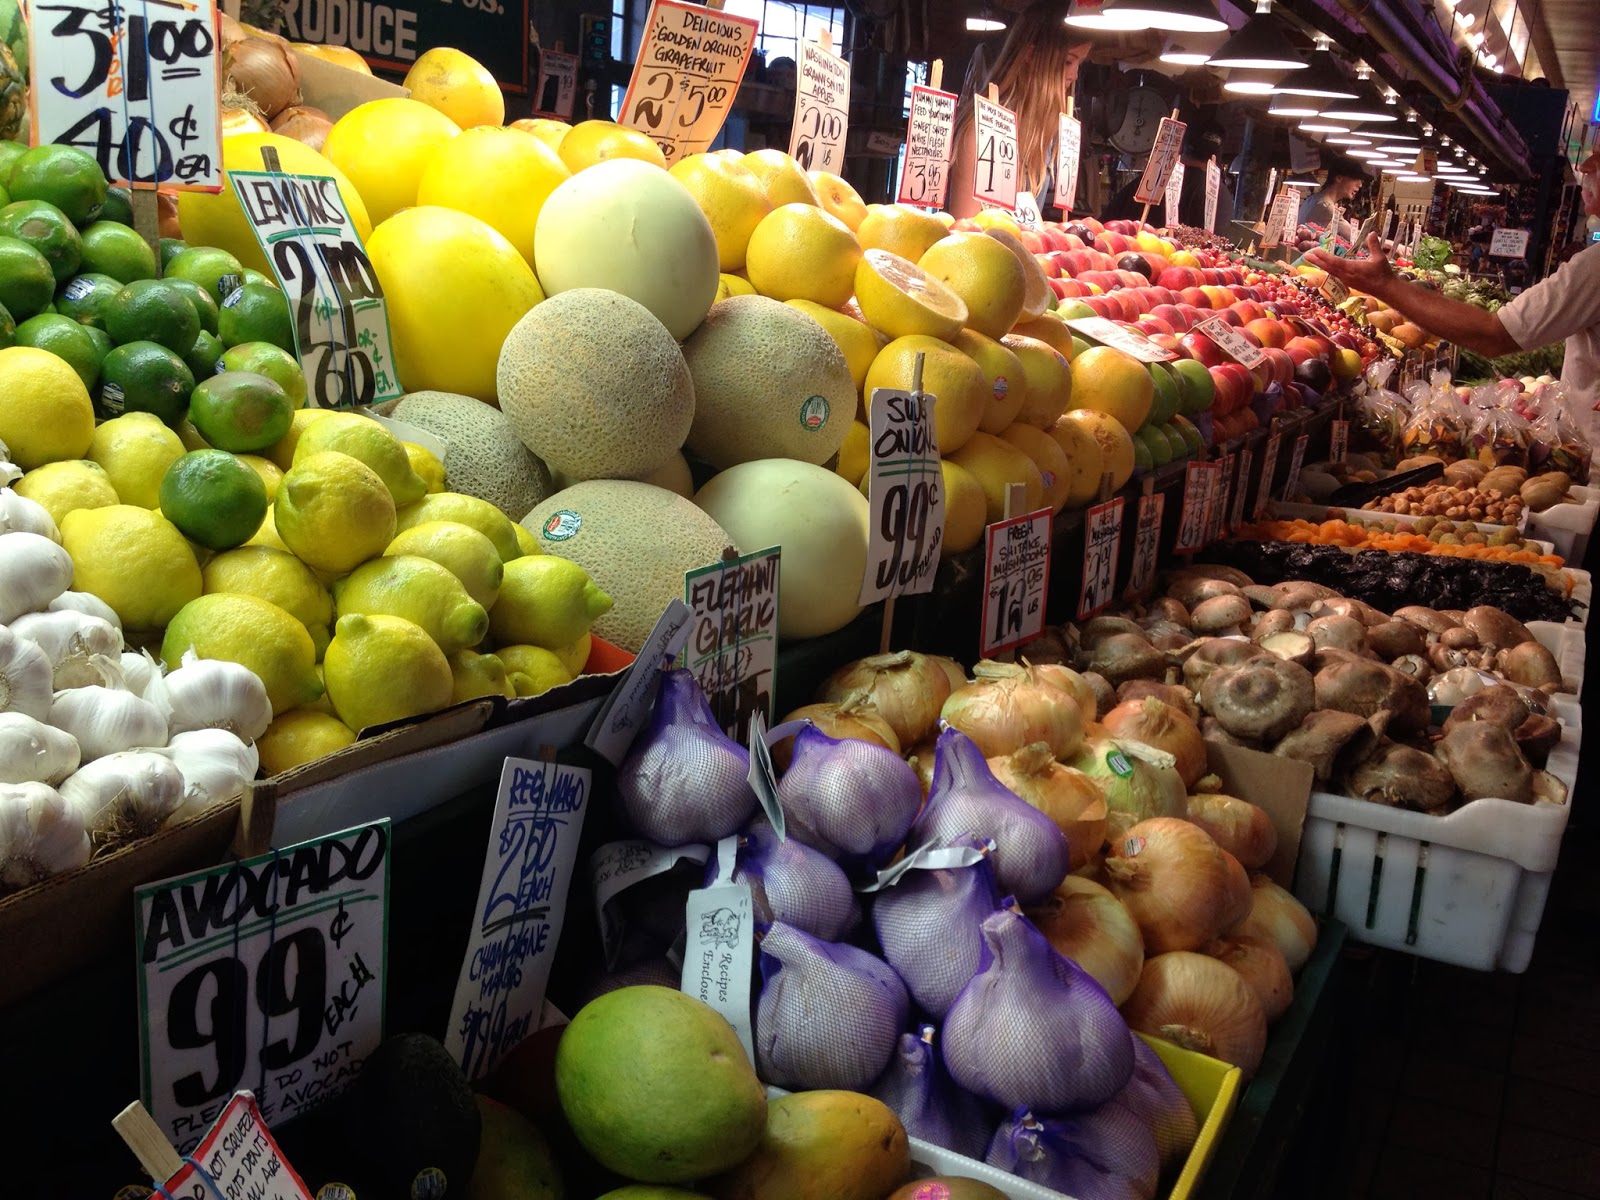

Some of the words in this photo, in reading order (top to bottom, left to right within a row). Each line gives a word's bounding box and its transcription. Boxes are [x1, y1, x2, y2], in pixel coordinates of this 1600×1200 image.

[278, 0, 418, 61] RODUCE
[657, 26, 702, 50] GOLDEN
[702, 40, 743, 58] ORCHID
[683, 11, 742, 41] DELICIOUS
[654, 46, 726, 74] GRAPEFRUIT
[812, 84, 835, 103] APPLES
[236, 178, 345, 227] LEMONS
[999, 535, 1041, 561] SHITAKE
[1006, 518, 1034, 542] FRESH
[691, 552, 781, 616] ELEPHANT
[993, 544, 1049, 577] MUSHROOMS
[695, 598, 775, 655] GARLIC
[142, 825, 387, 964] AVOCADO
[700, 949, 714, 1006] Enclose
[718, 951, 732, 1003] Recipes
[275, 1068, 303, 1090] DO
[313, 1040, 354, 1073] NOT
[240, 1131, 270, 1176] DENTS
